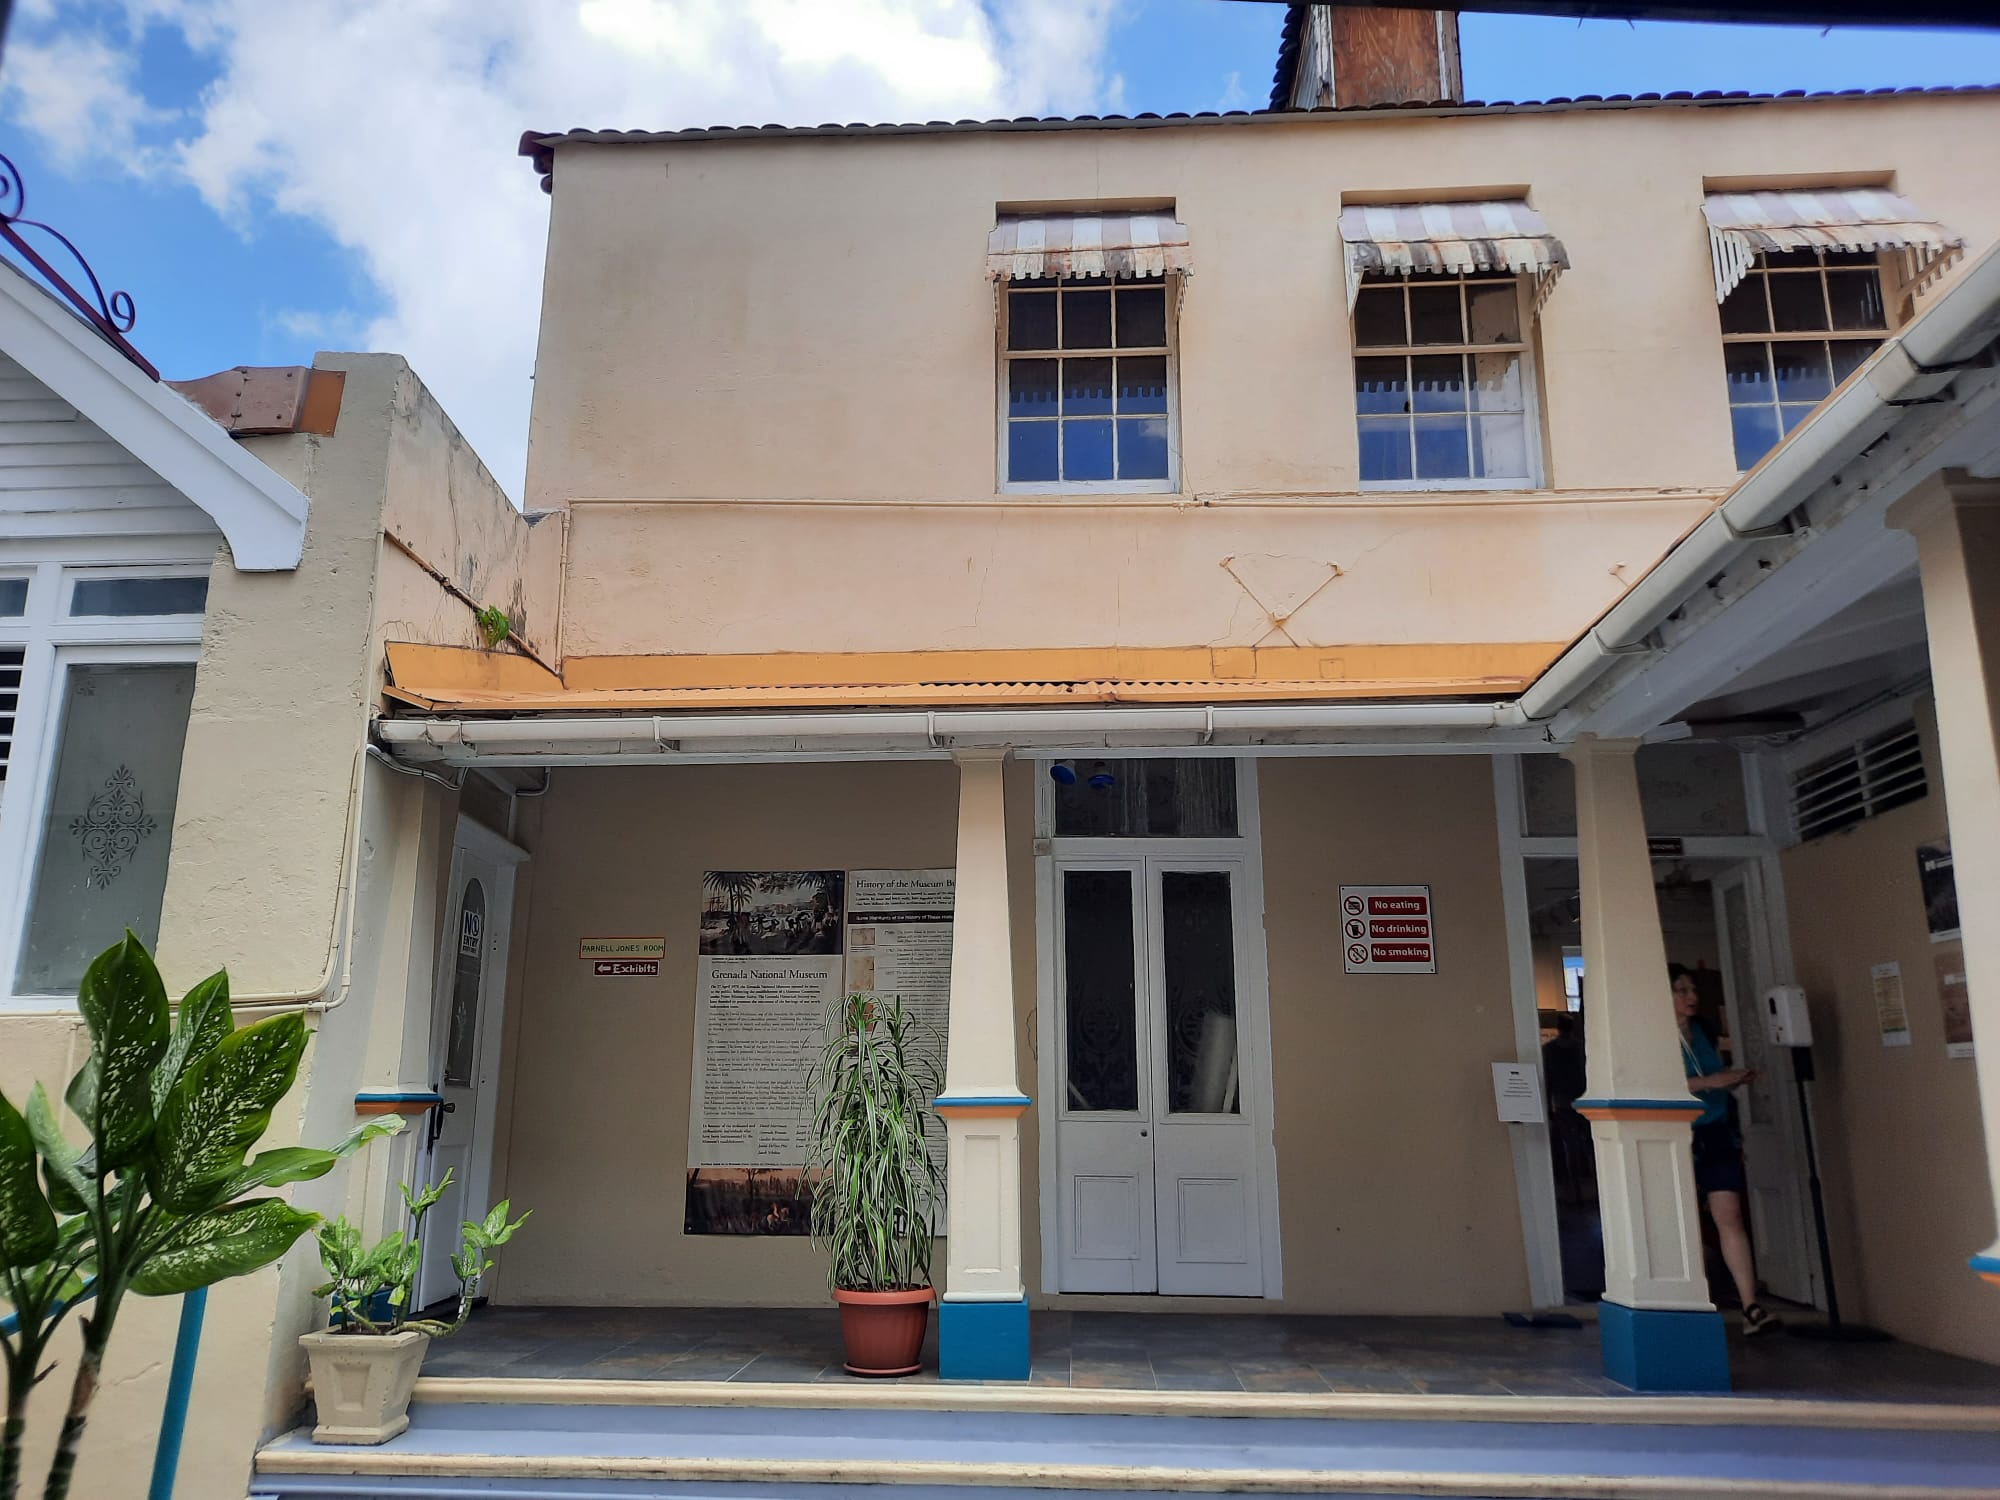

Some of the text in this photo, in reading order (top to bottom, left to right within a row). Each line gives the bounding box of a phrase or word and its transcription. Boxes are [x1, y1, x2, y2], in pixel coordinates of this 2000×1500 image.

[856, 880, 885, 889] History
[886, 880, 895, 888] of
[896, 880, 908, 888] the
[910, 880, 944, 888] Museum
[1374, 901, 1420, 911] No eating
[464, 911, 480, 936] NO
[1371, 924, 1427, 935] No drinking
[616, 944, 640, 952] JONES
[1373, 947, 1429, 957] No smoking
[612, 964, 657, 974] Exhibits
[711, 969, 828, 979] Grenada National Museum
